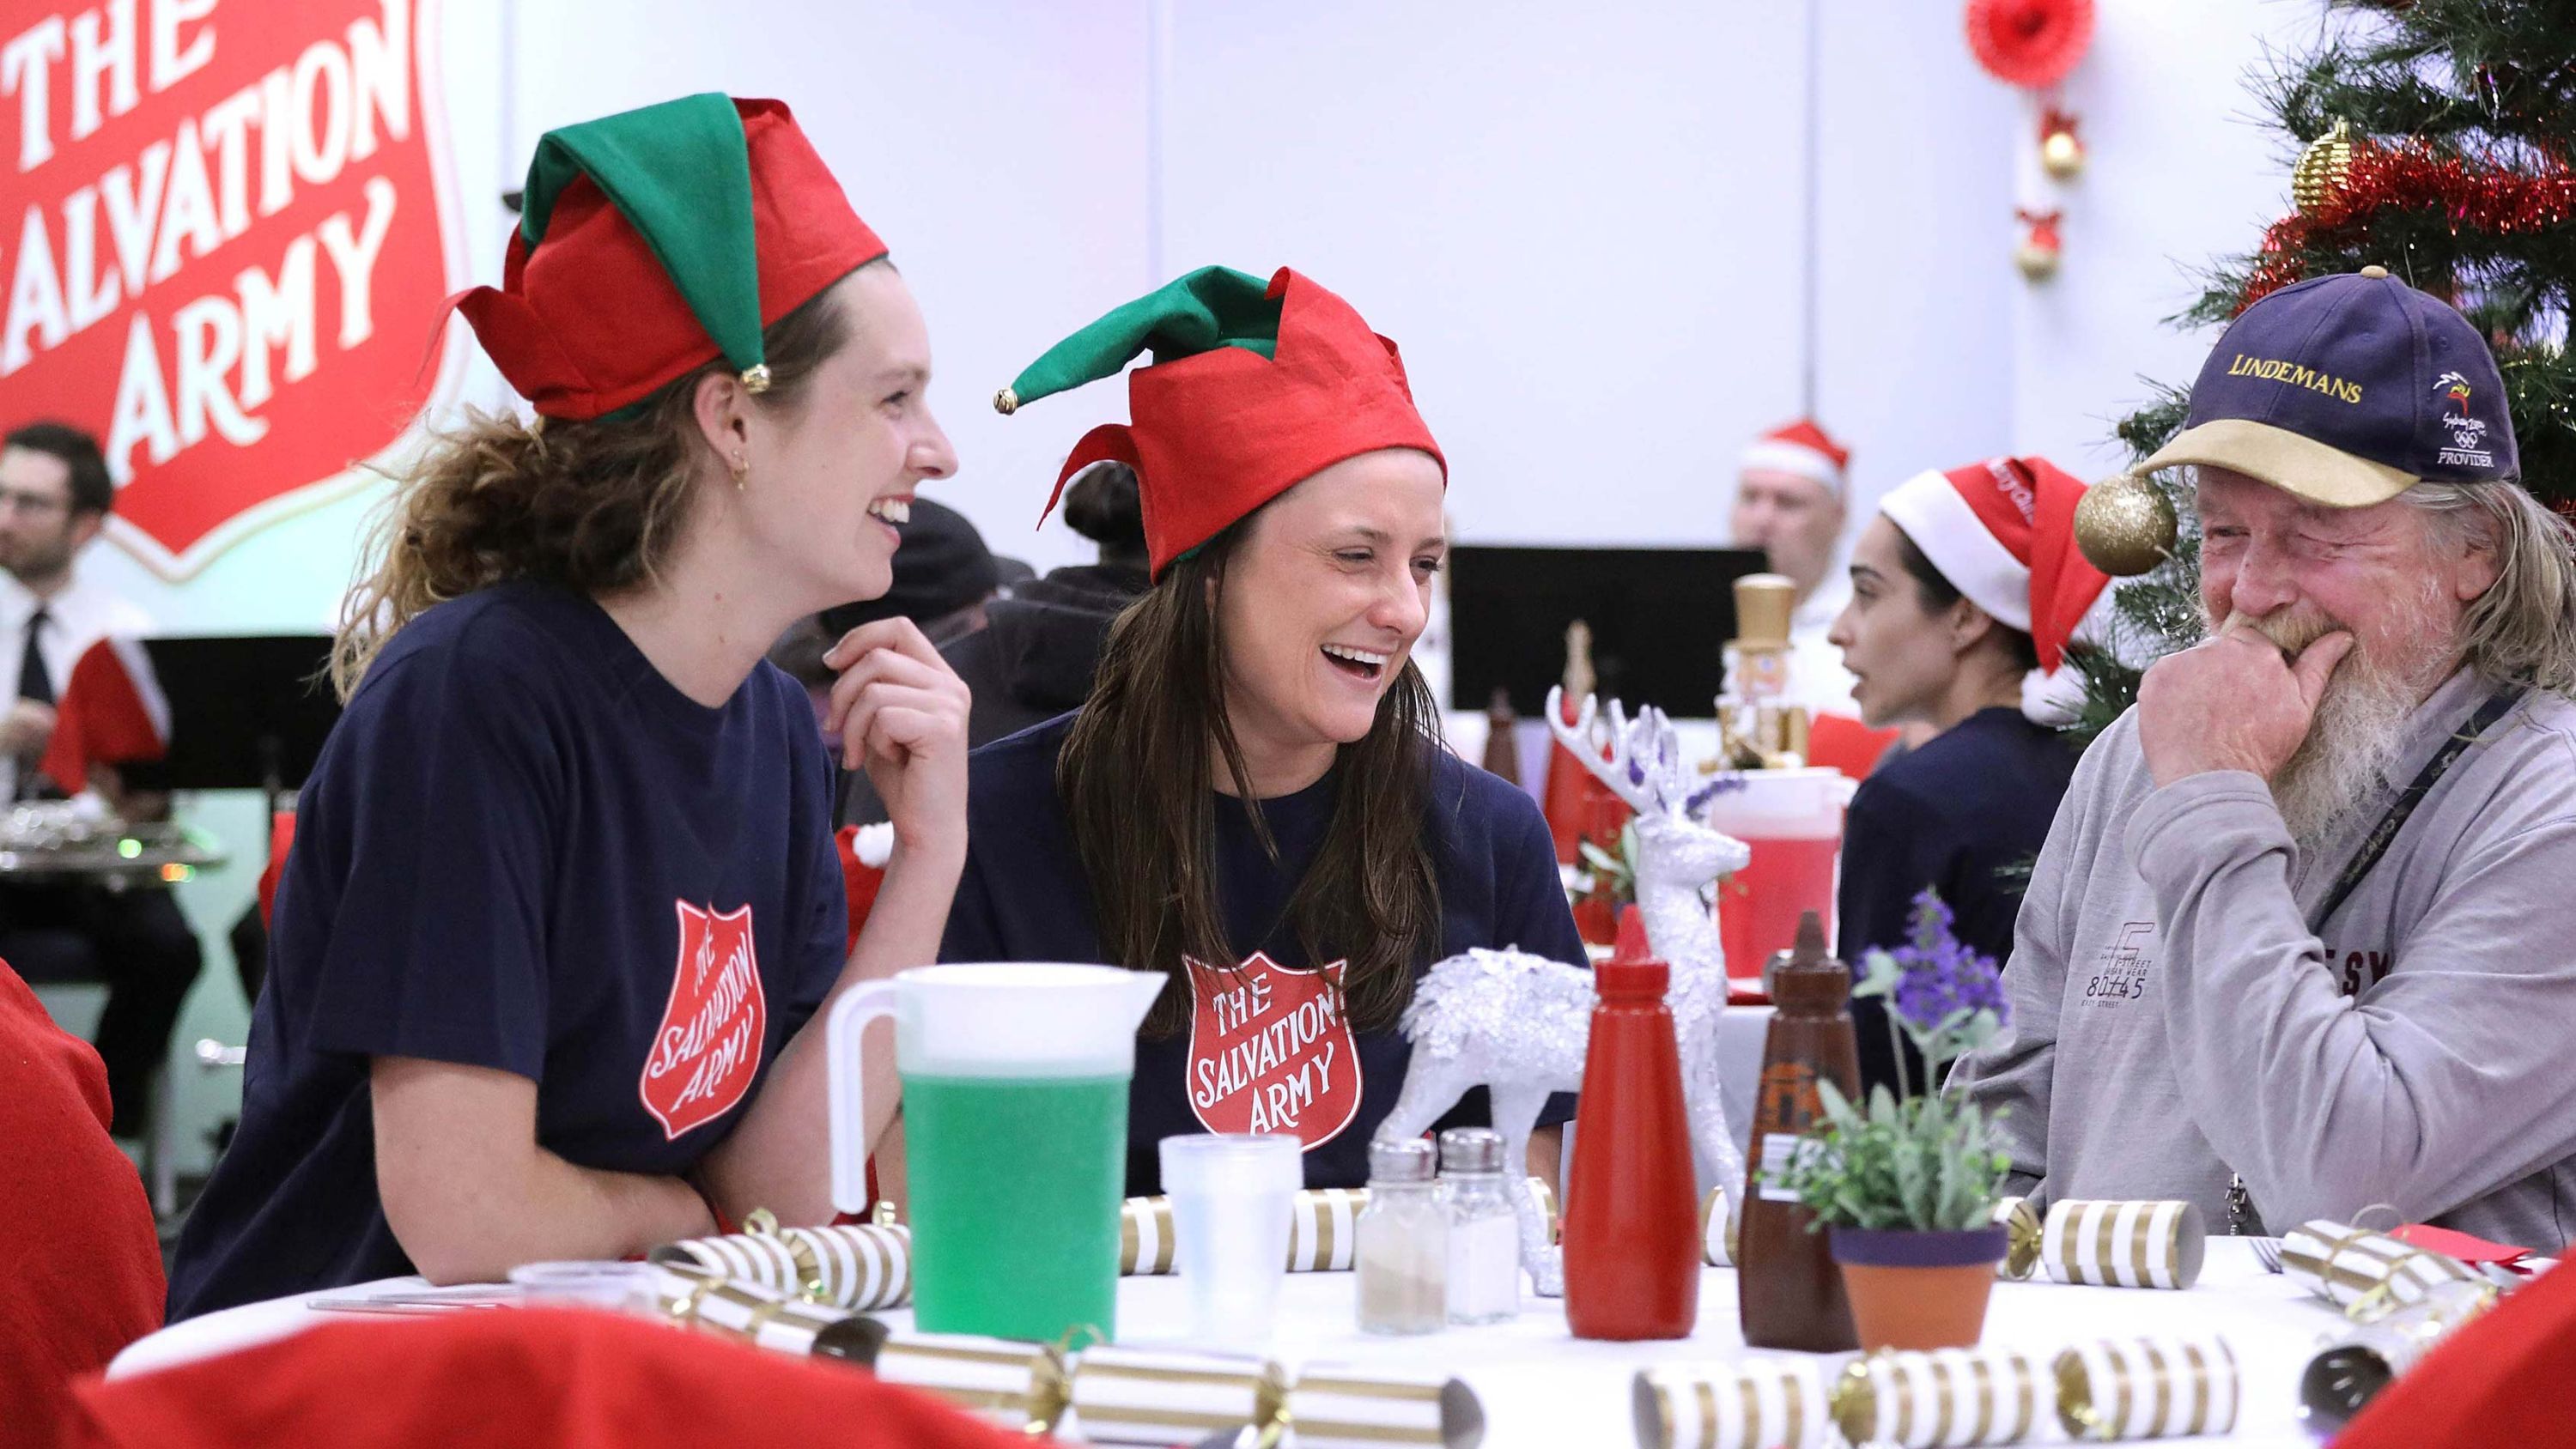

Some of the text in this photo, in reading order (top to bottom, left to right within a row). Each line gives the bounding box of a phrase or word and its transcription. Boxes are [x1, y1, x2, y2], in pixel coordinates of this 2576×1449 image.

[1, 0, 217, 173] THE
[0, 0, 410, 376] ALVATION
[106, 176, 396, 489] ARMY
[2227, 354, 2362, 403] LINDEMANS
[2437, 452, 2494, 468] PROVIDER
[650, 931, 752, 1078] SALVATION
[670, 1003, 754, 1113] ARMY
[1196, 981, 1337, 1108] SALVATION
[1212, 972, 1272, 1037] THE
[1250, 1041, 1334, 1136] ARMY
